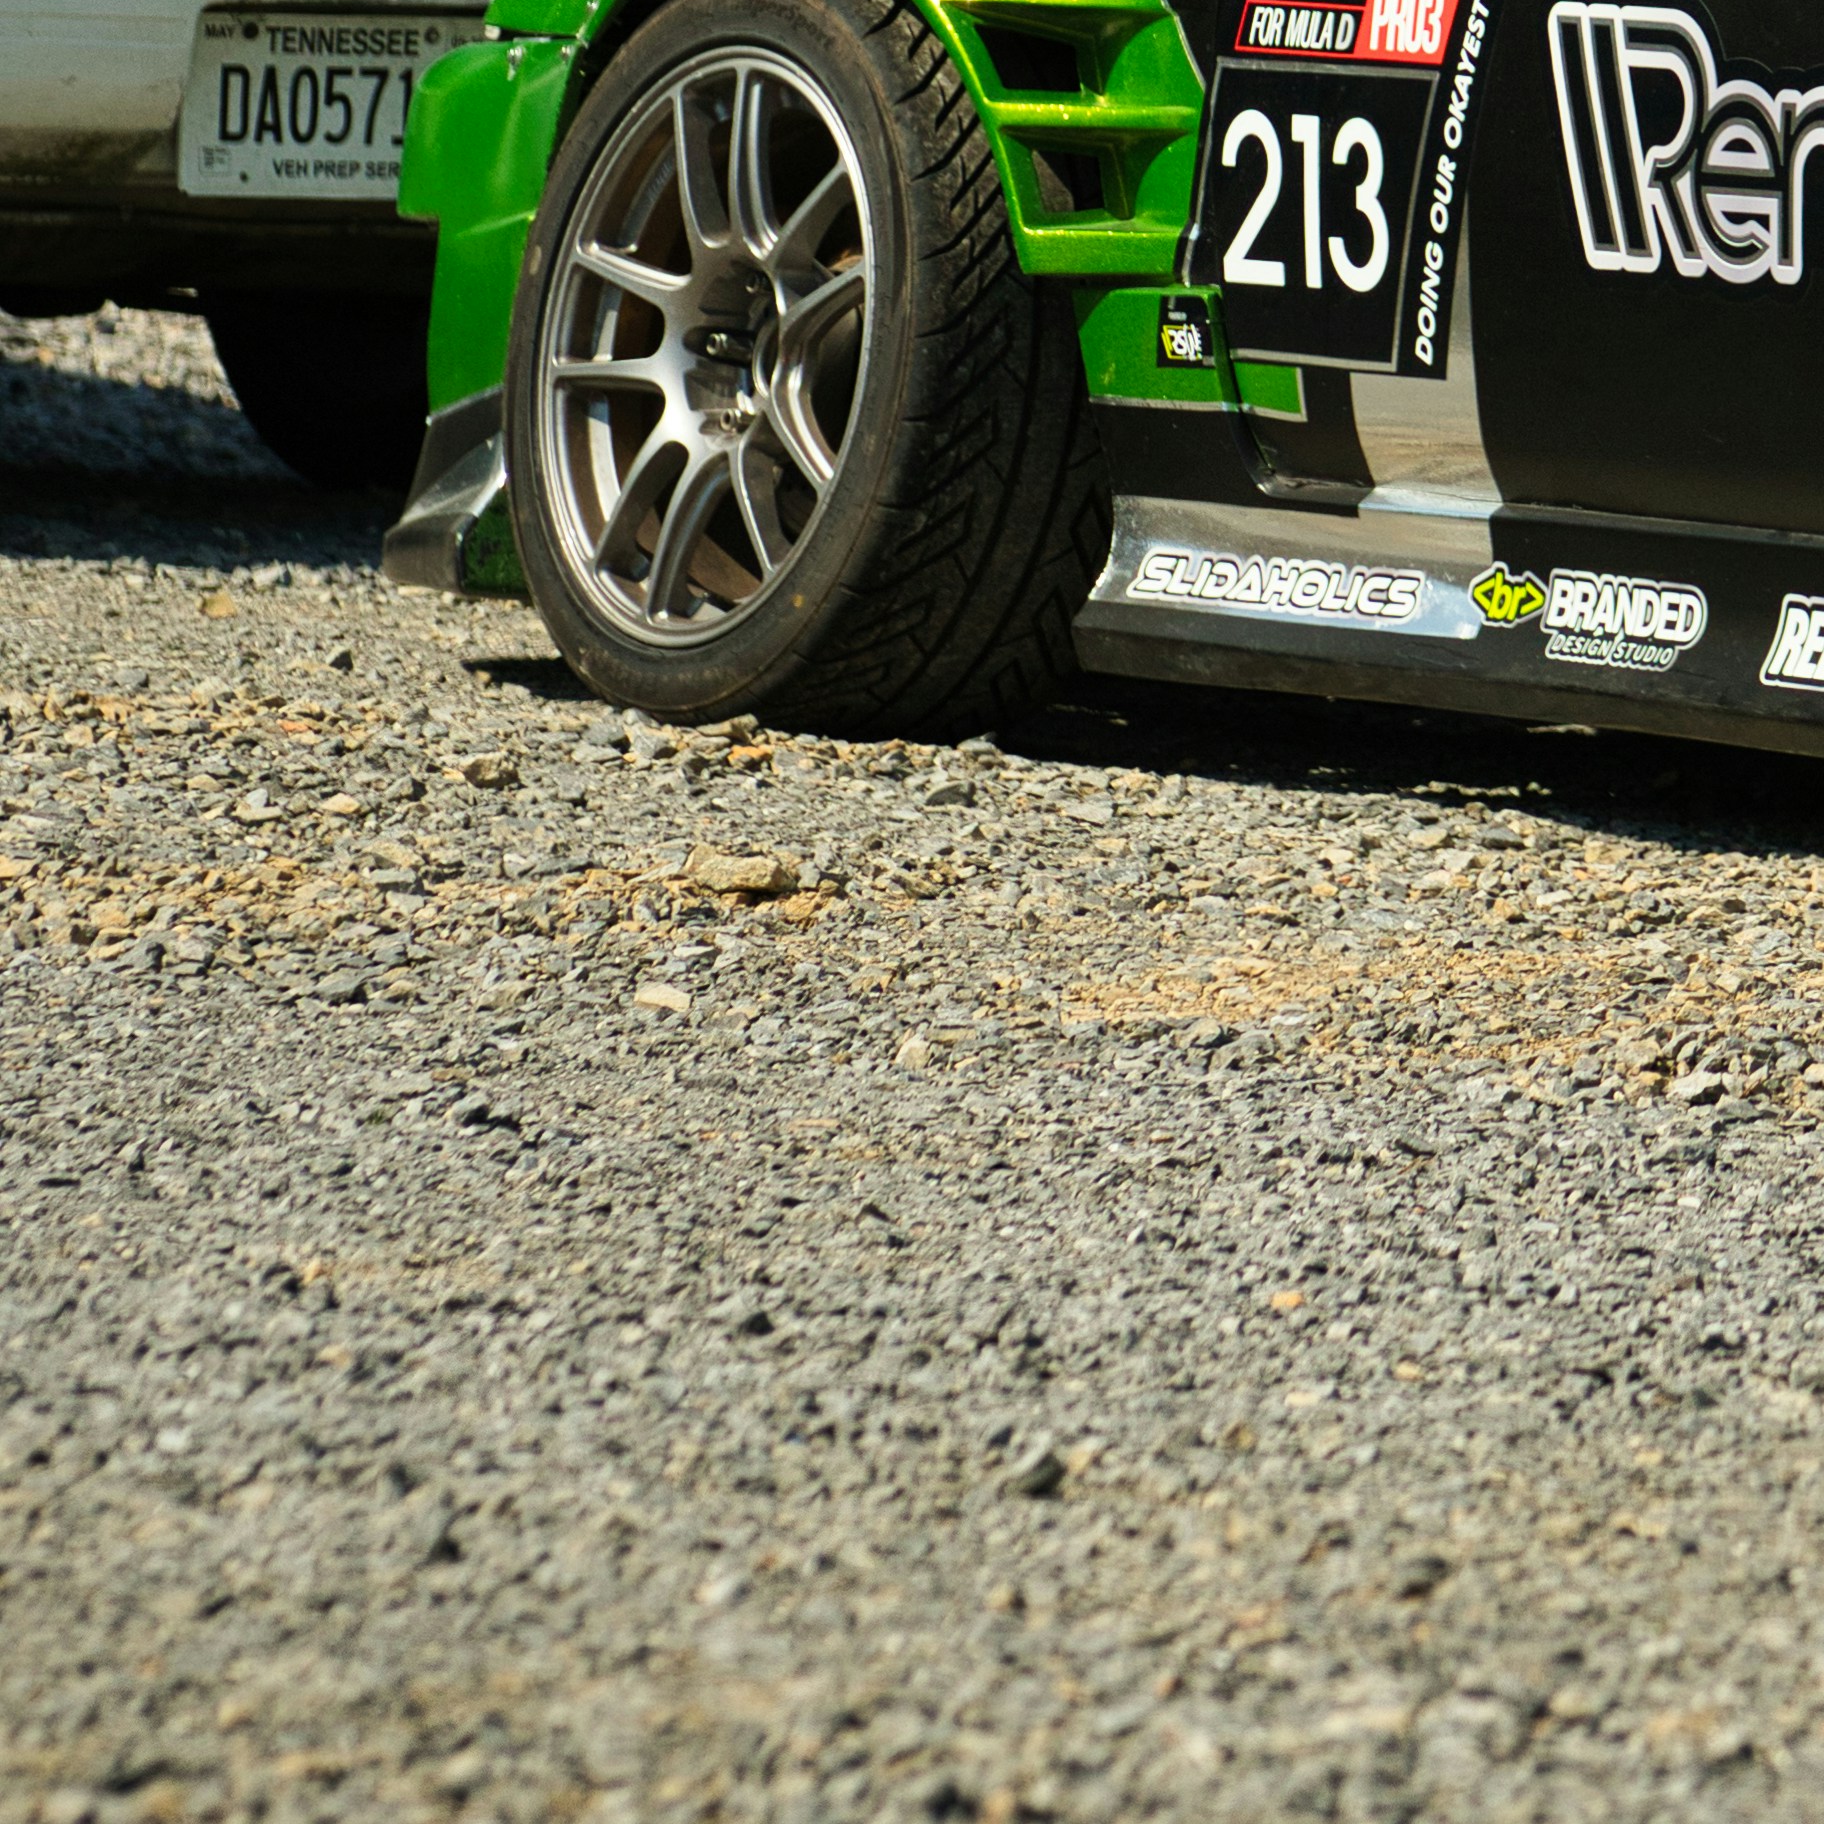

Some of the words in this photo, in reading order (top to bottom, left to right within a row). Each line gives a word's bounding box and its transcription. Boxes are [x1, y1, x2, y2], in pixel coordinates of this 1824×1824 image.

[264, 26, 420, 56] TENNESSEE
[1335, 12, 1356, 51] D
[273, 159, 308, 177] VEH
[313, 159, 359, 179] PREP
[1220, 108, 1390, 293] 213
[1415, 241, 1445, 367] DOING
[1430, 154, 1458, 235] OUR
[1133, 553, 1422, 619] SLIDAHOLICS
[1545, 577, 1703, 643] BRANDED
[1551, 632, 1614, 658] DESIGN
[1612, 641, 1675, 666] STUDIO
